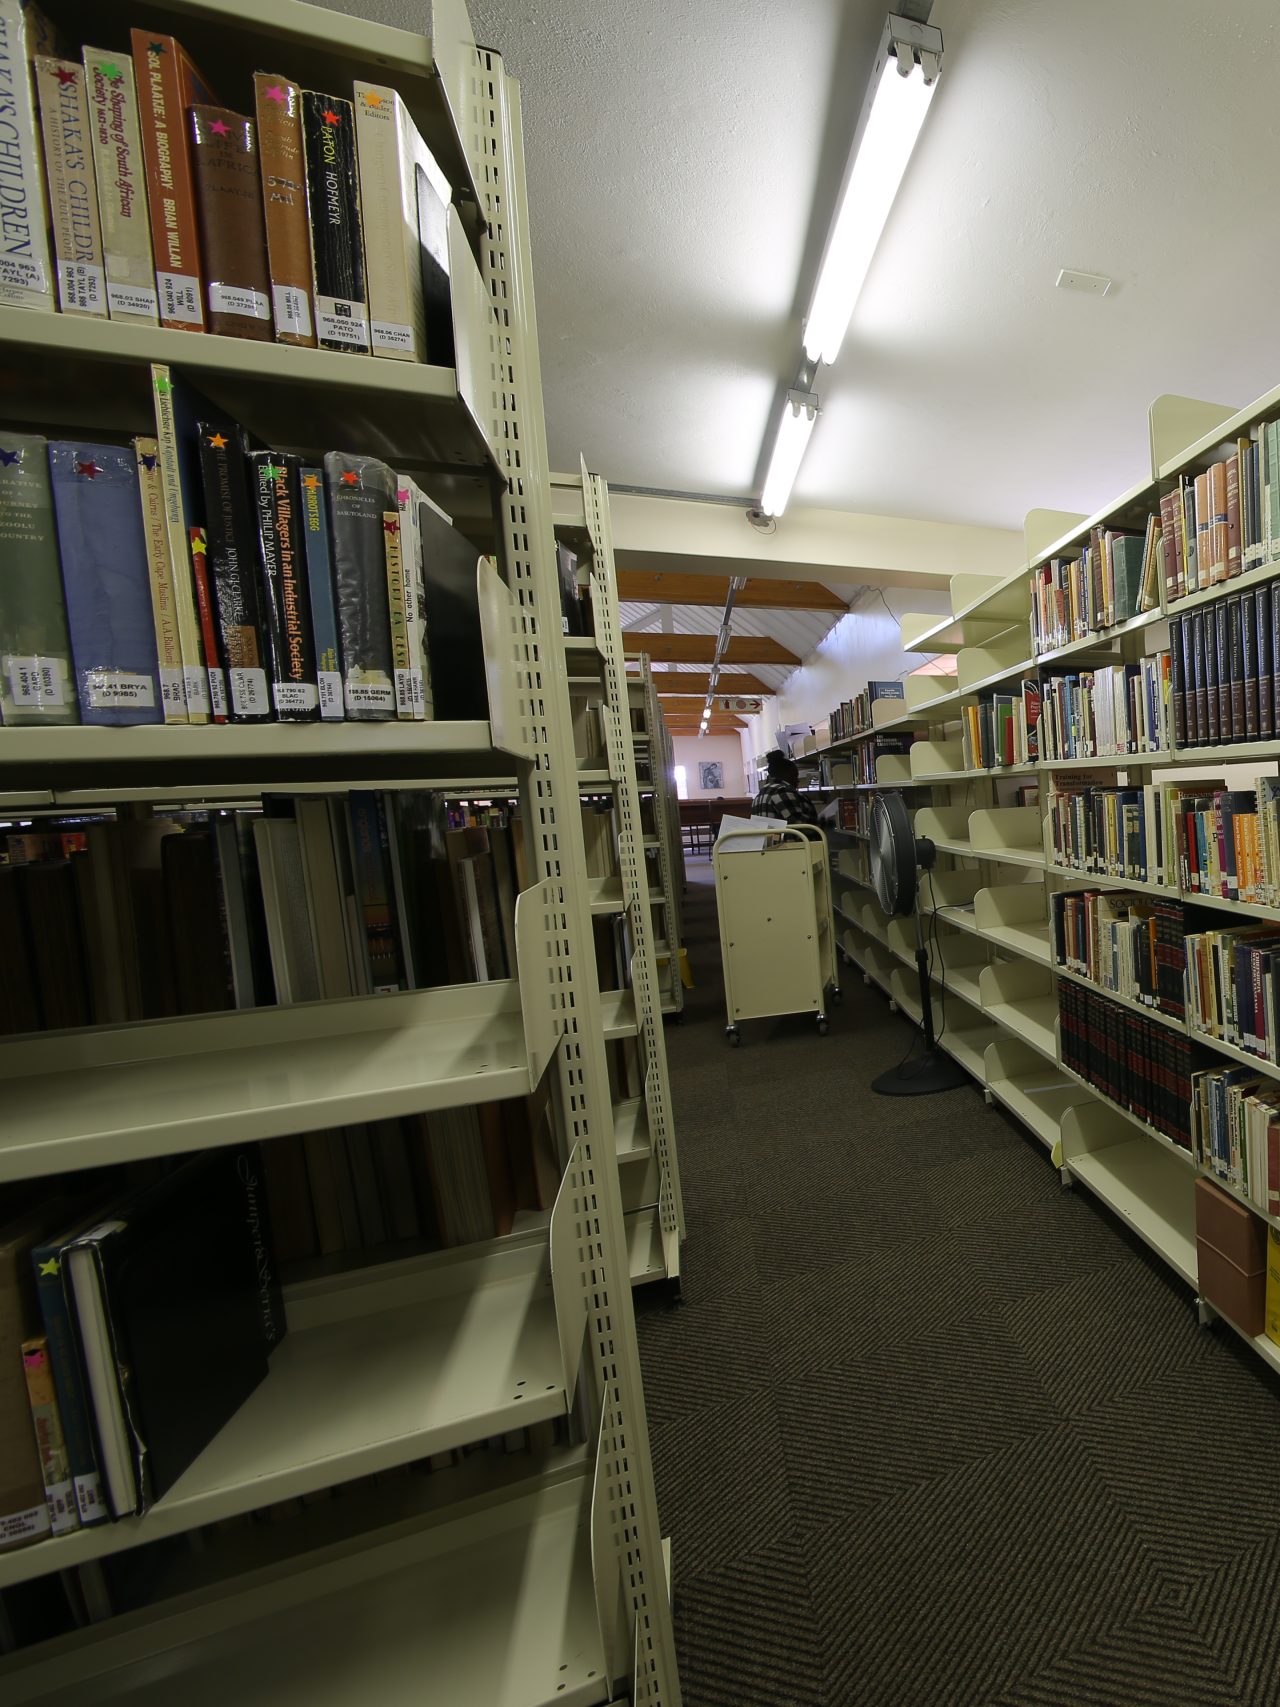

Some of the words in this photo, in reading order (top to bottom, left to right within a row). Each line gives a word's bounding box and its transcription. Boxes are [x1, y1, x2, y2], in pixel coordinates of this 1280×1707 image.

[147, 51, 161, 74] SOL
[111, 90, 127, 133] Shaping
[150, 77, 166, 120] PLAATJE:
[365, 109, 391, 121] Editors
[59, 83, 86, 172] SHAKA'S
[156, 131, 174, 189] BIOGRAPHY
[320, 125, 336, 165] PATON
[117, 147, 132, 177] South
[0, 117, 33, 258] CHILDREN
[115, 180, 135, 217] African
[325, 171, 341, 226] HOFMEYR
[163, 198, 178, 229] BRIAN
[166, 231, 182, 268] WILLAN
[333, 325, 355, 334] PATO
[275, 466, 289, 496] Black
[337, 494, 375, 504] CHRONICLES
[337, 510, 377, 519] BASUTOLAND
[262, 509, 274, 538] PHILIP
[276, 499, 293, 548] Villagers
[227, 547, 240, 570] JOHN
[265, 541, 278, 576] MAYER
[158, 581, 170, 610] Muslims
[284, 580, 300, 634] Industrial
[289, 637, 304, 681] Society
[120, 683, 148, 694] BRYA
[371, 690, 392, 699] GERM
